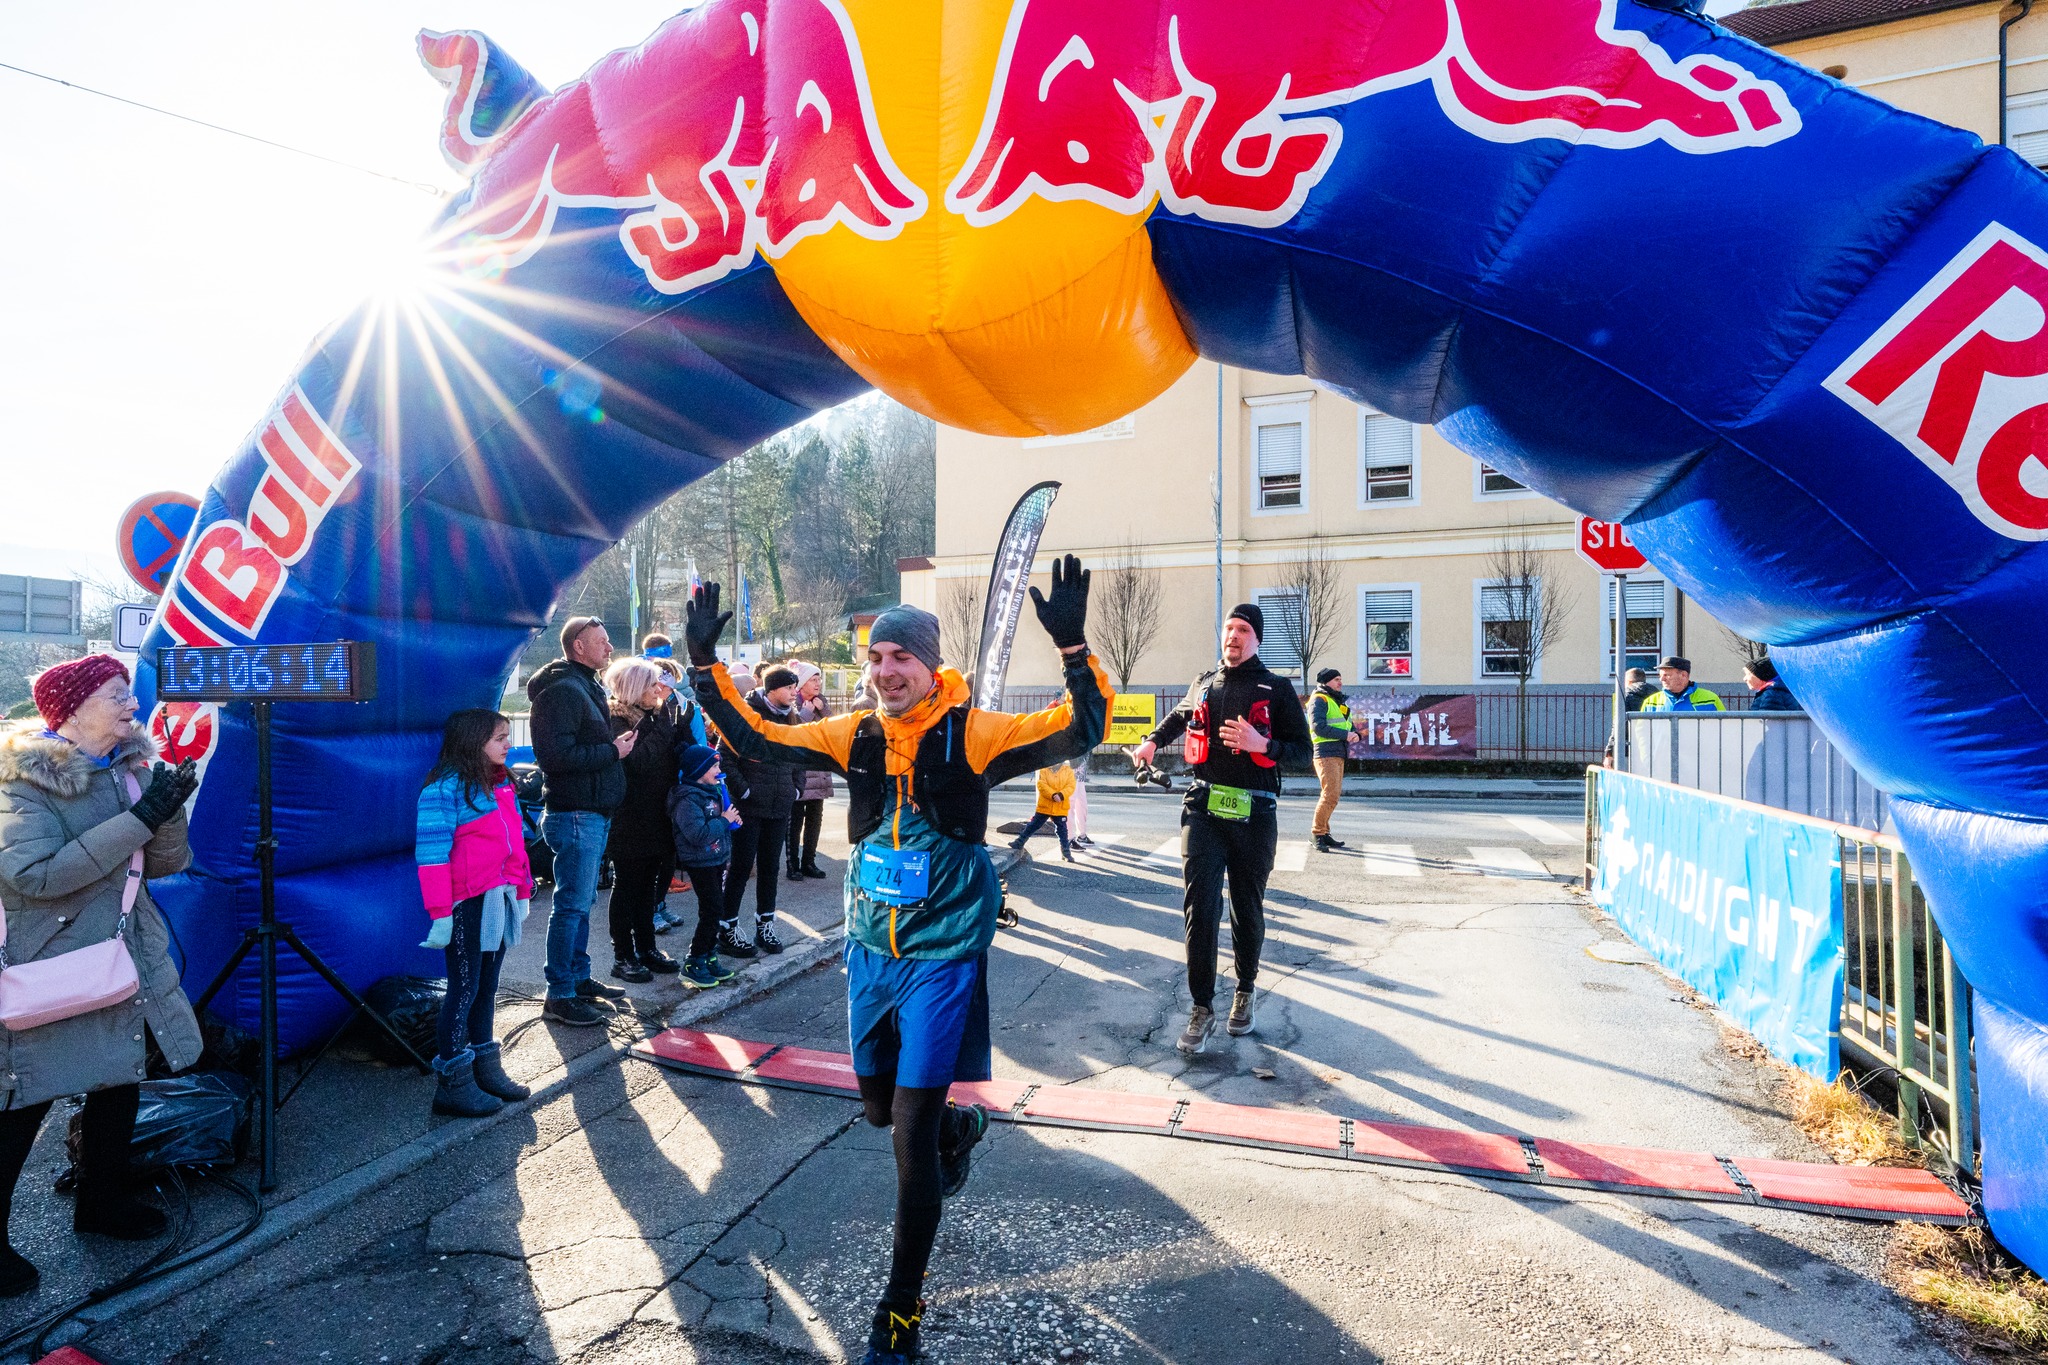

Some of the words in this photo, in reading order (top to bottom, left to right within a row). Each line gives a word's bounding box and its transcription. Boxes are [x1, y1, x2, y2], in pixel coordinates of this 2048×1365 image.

[183, 388, 357, 634] Bull
[164, 646, 349, 691] 13:06:14
[1365, 712, 1459, 746] TRAIL
[1220, 796, 1238, 809] 408
[875, 865, 902, 887] 274
[1638, 842, 1816, 975] RAIDLIGHT
